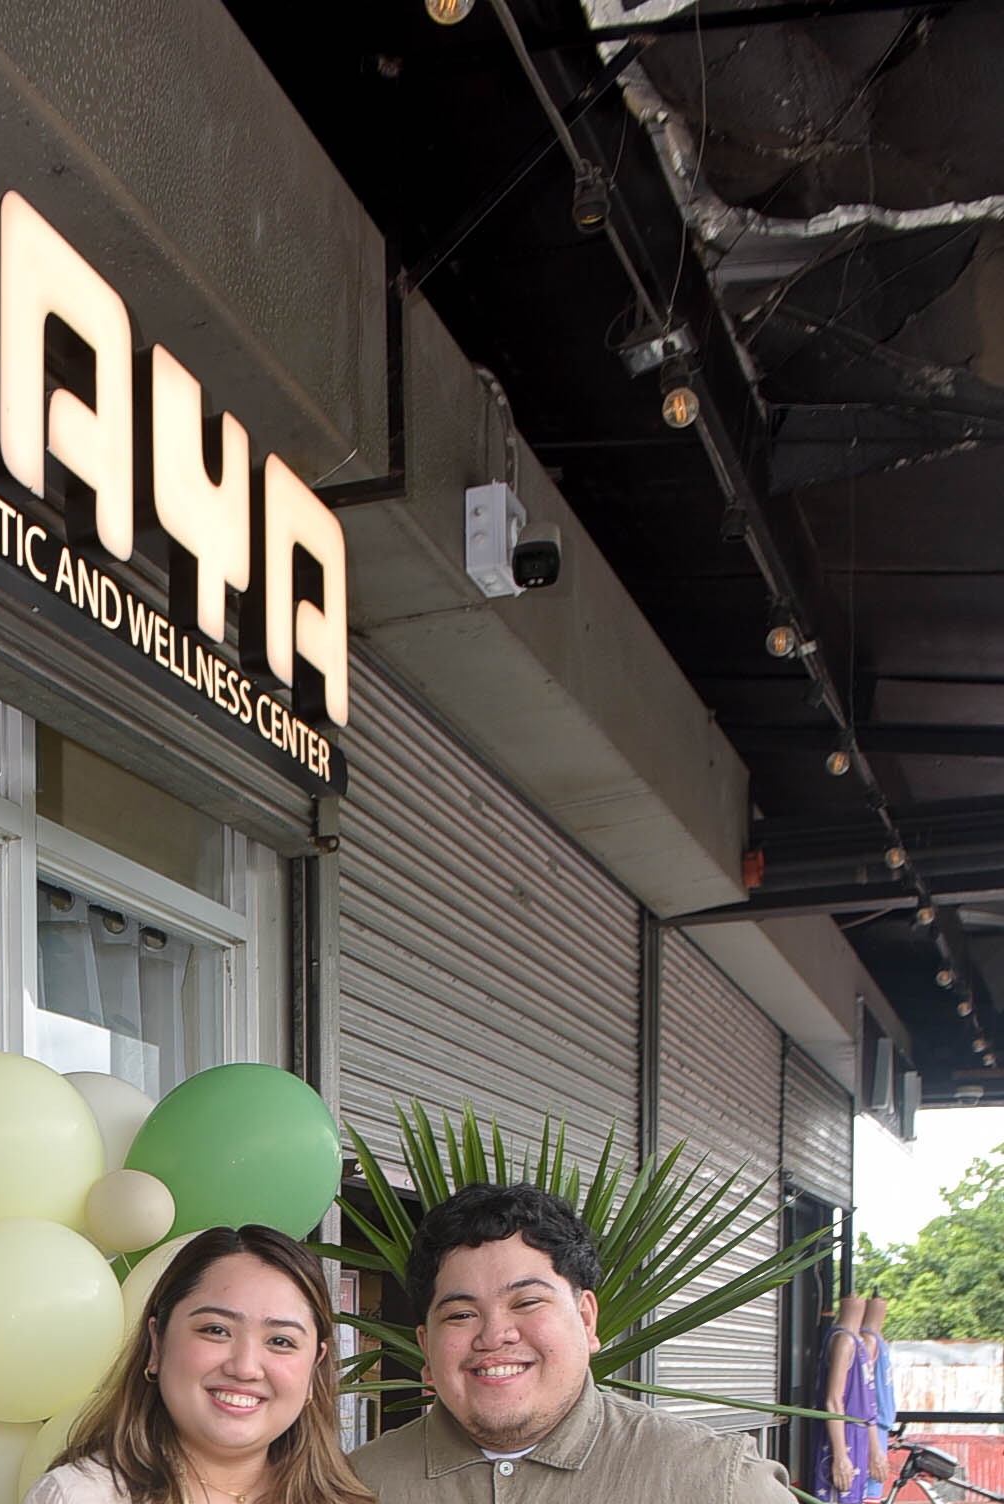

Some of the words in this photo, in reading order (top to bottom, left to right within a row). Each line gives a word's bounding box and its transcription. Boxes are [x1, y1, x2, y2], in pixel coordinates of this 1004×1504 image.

[54, 546, 122, 630] AND
[126, 593, 253, 724] WELLNESS
[256, 694, 331, 783] CENTER
